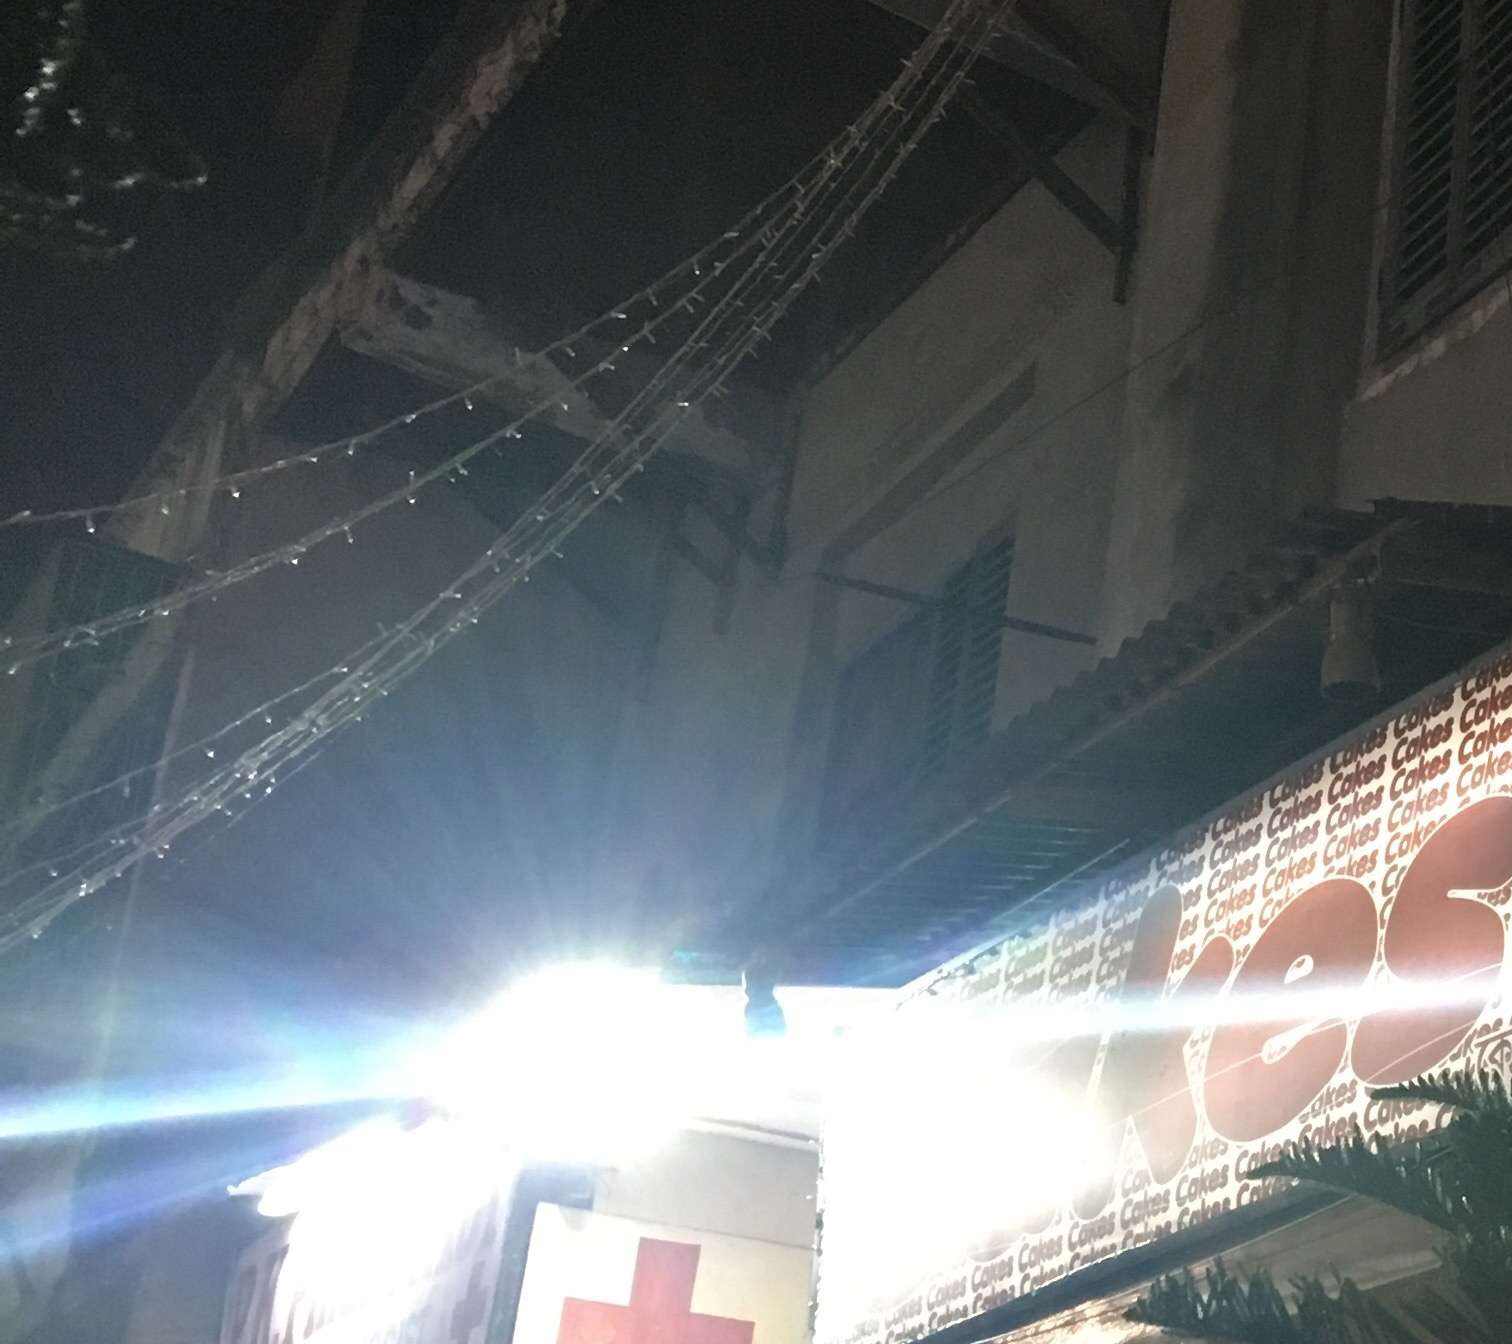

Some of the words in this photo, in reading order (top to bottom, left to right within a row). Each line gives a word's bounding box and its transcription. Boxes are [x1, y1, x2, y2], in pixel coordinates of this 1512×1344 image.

[1207, 853, 1260, 900] Cakes
[1265, 820, 1321, 869] Cakes
[1325, 785, 1385, 836] Cakes
[1389, 748, 1452, 802] Cakes
[1267, 789, 1323, 839] Cakes
[1327, 754, 1387, 805] Cakes
[1391, 717, 1454, 771] Cakes
[1204, 883, 1257, 929] Cakes
[1262, 851, 1318, 899] Cakes
[1323, 817, 1382, 867] Cakes
[1387, 782, 1450, 833] Cakes
[1175, 1164, 1229, 1207] Cakes
